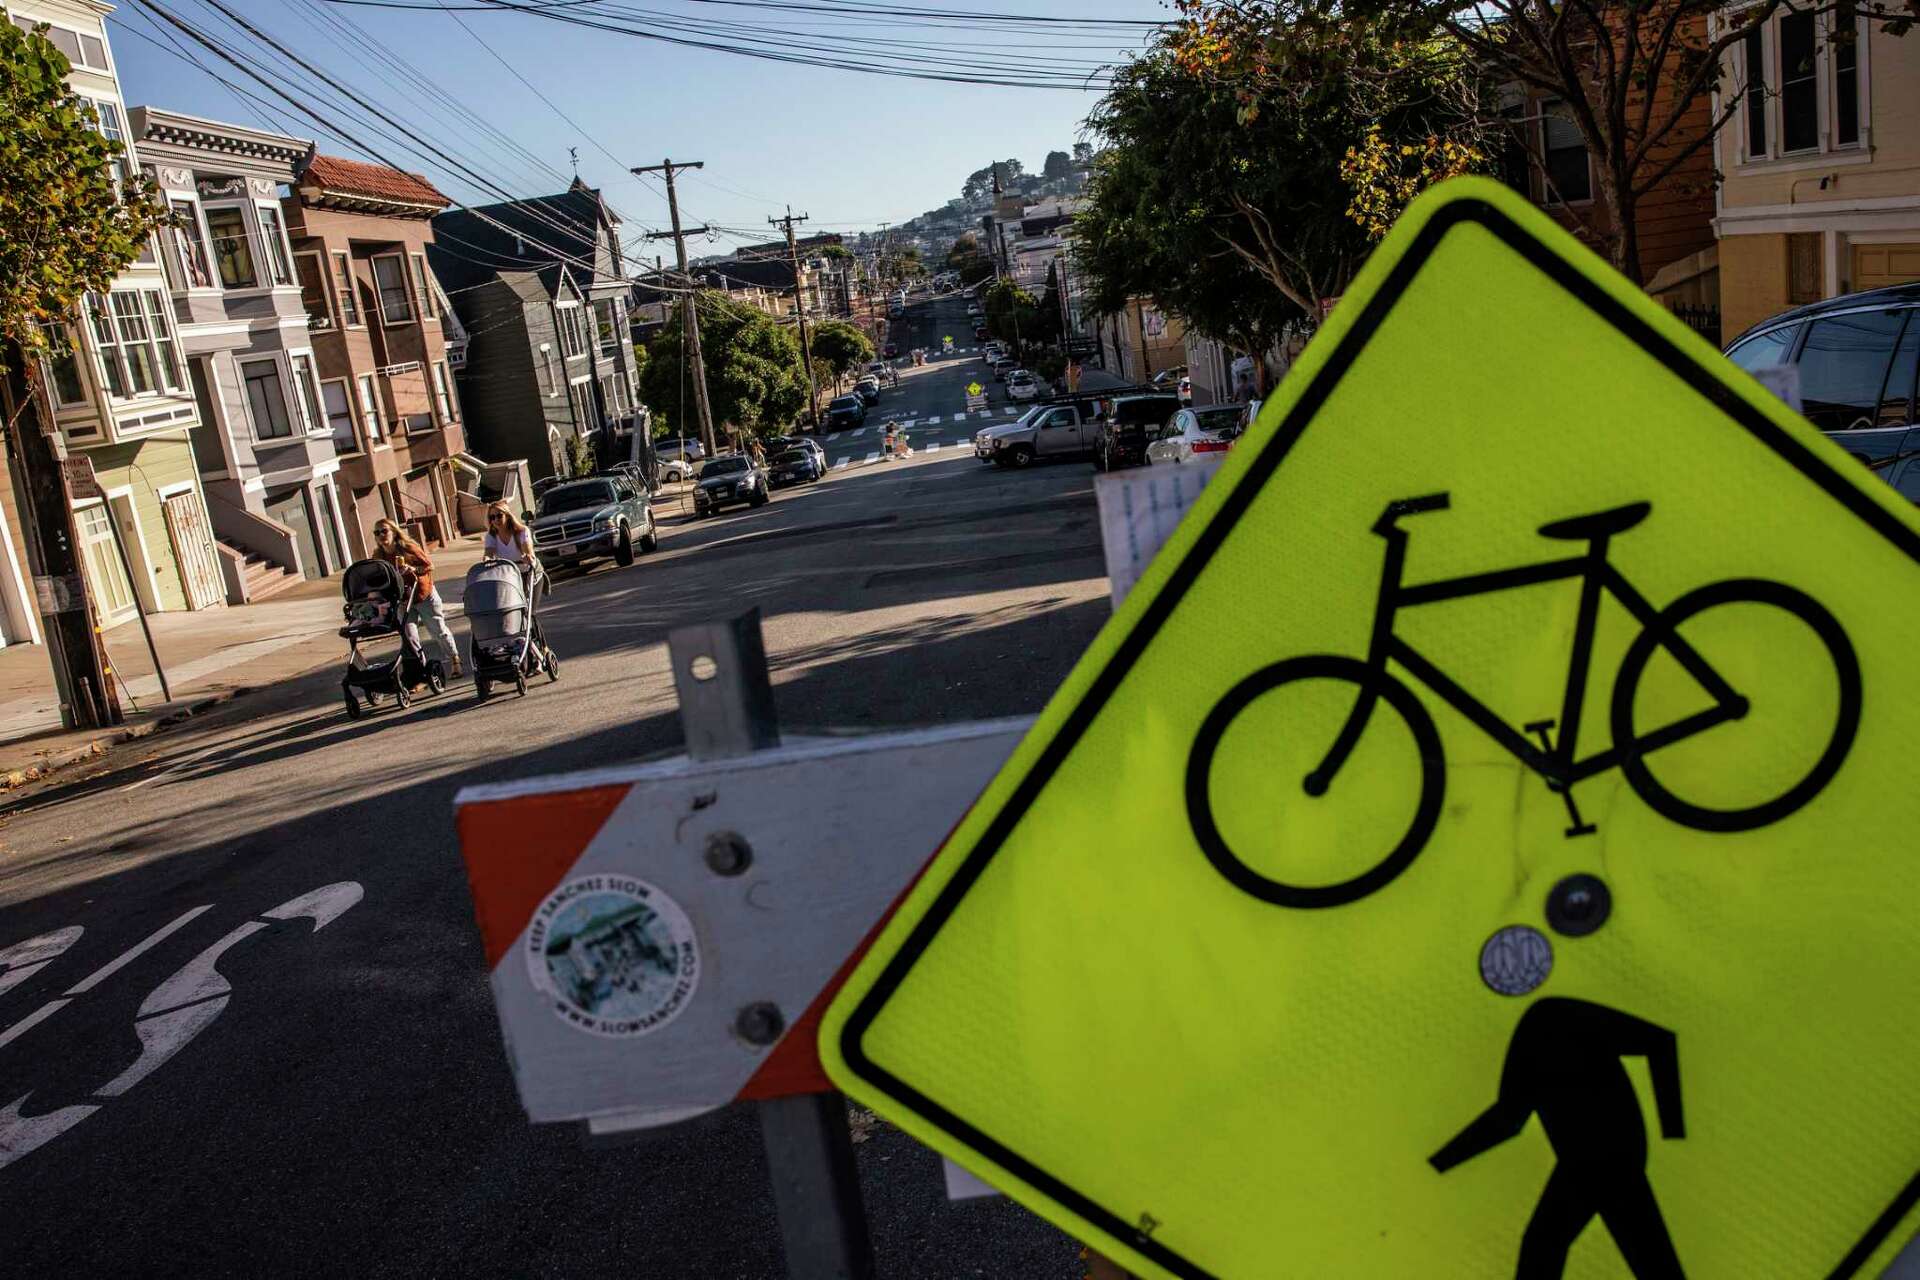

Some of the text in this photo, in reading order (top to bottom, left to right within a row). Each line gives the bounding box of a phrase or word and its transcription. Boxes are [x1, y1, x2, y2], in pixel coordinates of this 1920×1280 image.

[530, 878, 650, 952] KEEP SANCHEZ SLOW
